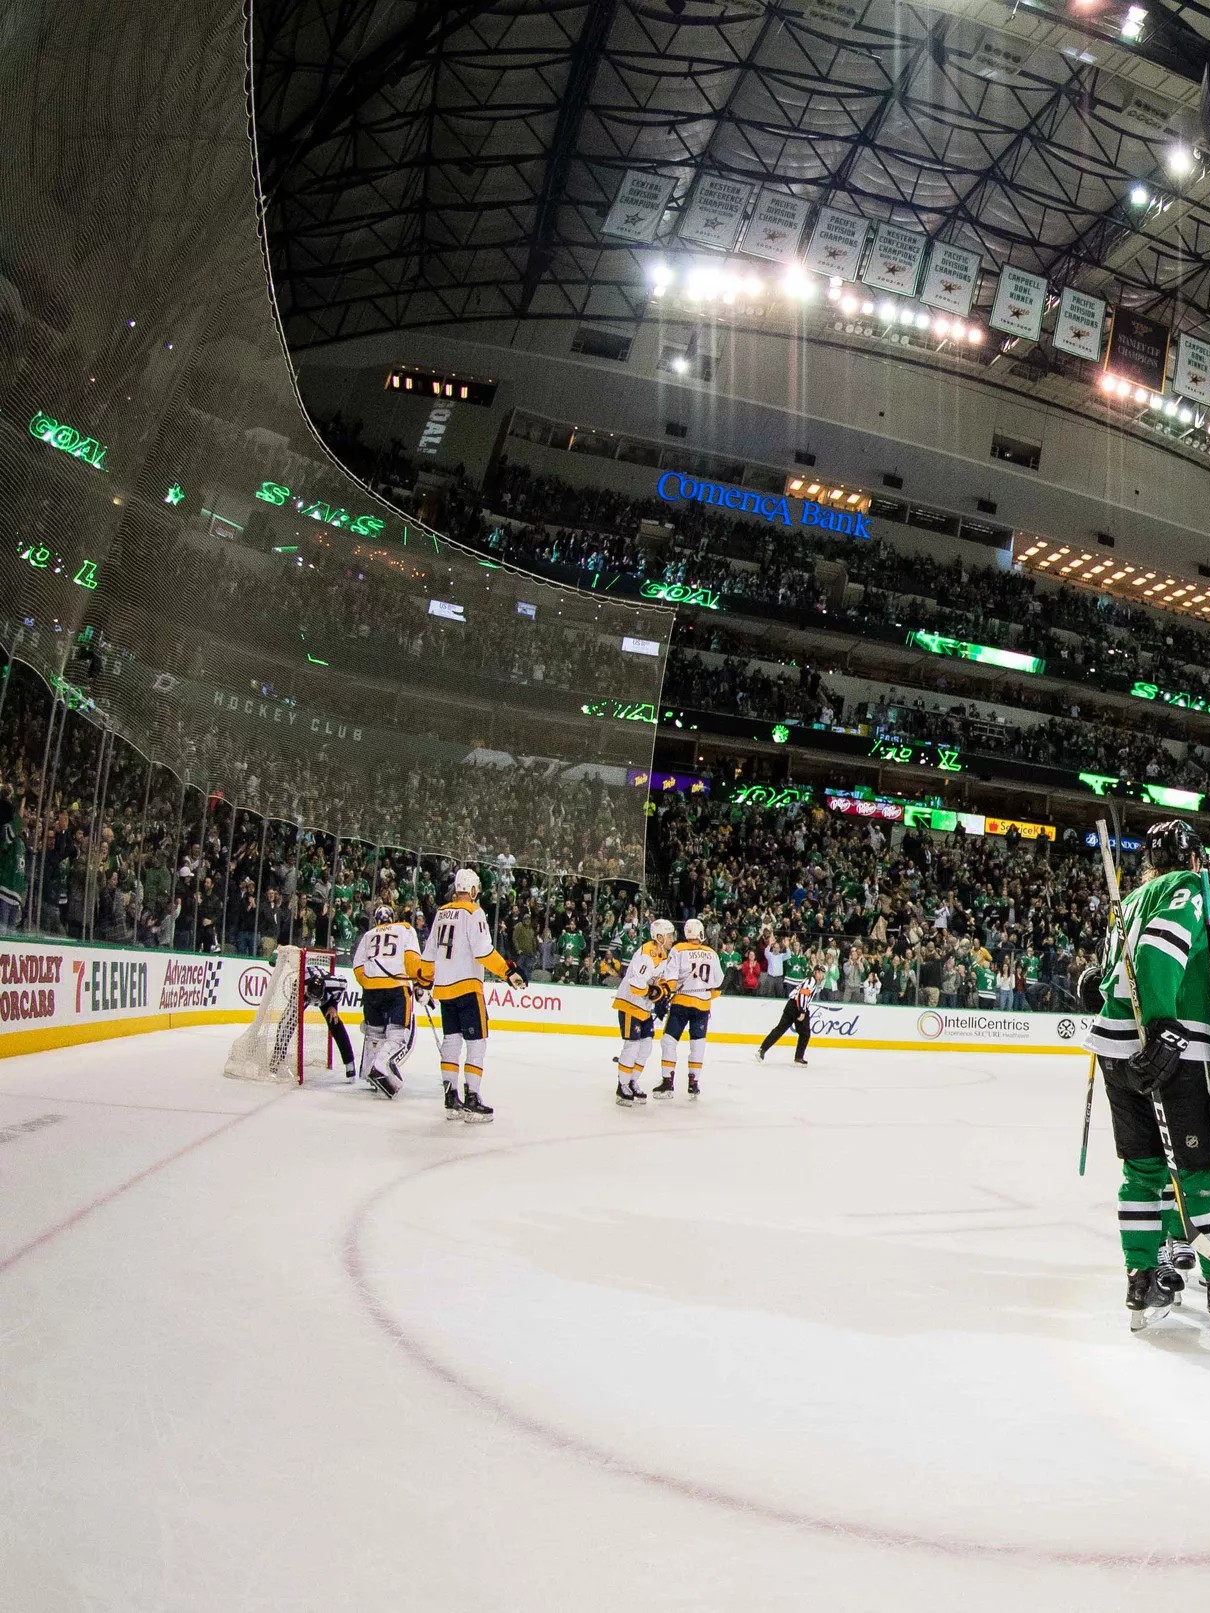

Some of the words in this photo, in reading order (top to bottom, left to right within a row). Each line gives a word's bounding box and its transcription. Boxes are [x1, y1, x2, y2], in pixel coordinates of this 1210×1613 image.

[800, 500, 873, 540] Bank
[214, 691, 297, 725] HOCKEY
[311, 718, 363, 742] CLUB
[1151, 838, 1162, 848] 24
[368, 933, 398, 959] 35
[437, 925, 455, 960] 14
[688, 951, 712, 960] SISSONS
[0, 954, 63, 986] TANDLEY
[164, 958, 204, 986] Advance
[639, 965, 647, 975] 8
[0, 989, 55, 1022] ORCARS
[484, 989, 561, 1011] AA.com
[944, 1016, 1030, 1031] IntelliCentrics
[1160, 1029, 1189, 1050] CC
[1153, 1100, 1177, 1170] CCM
